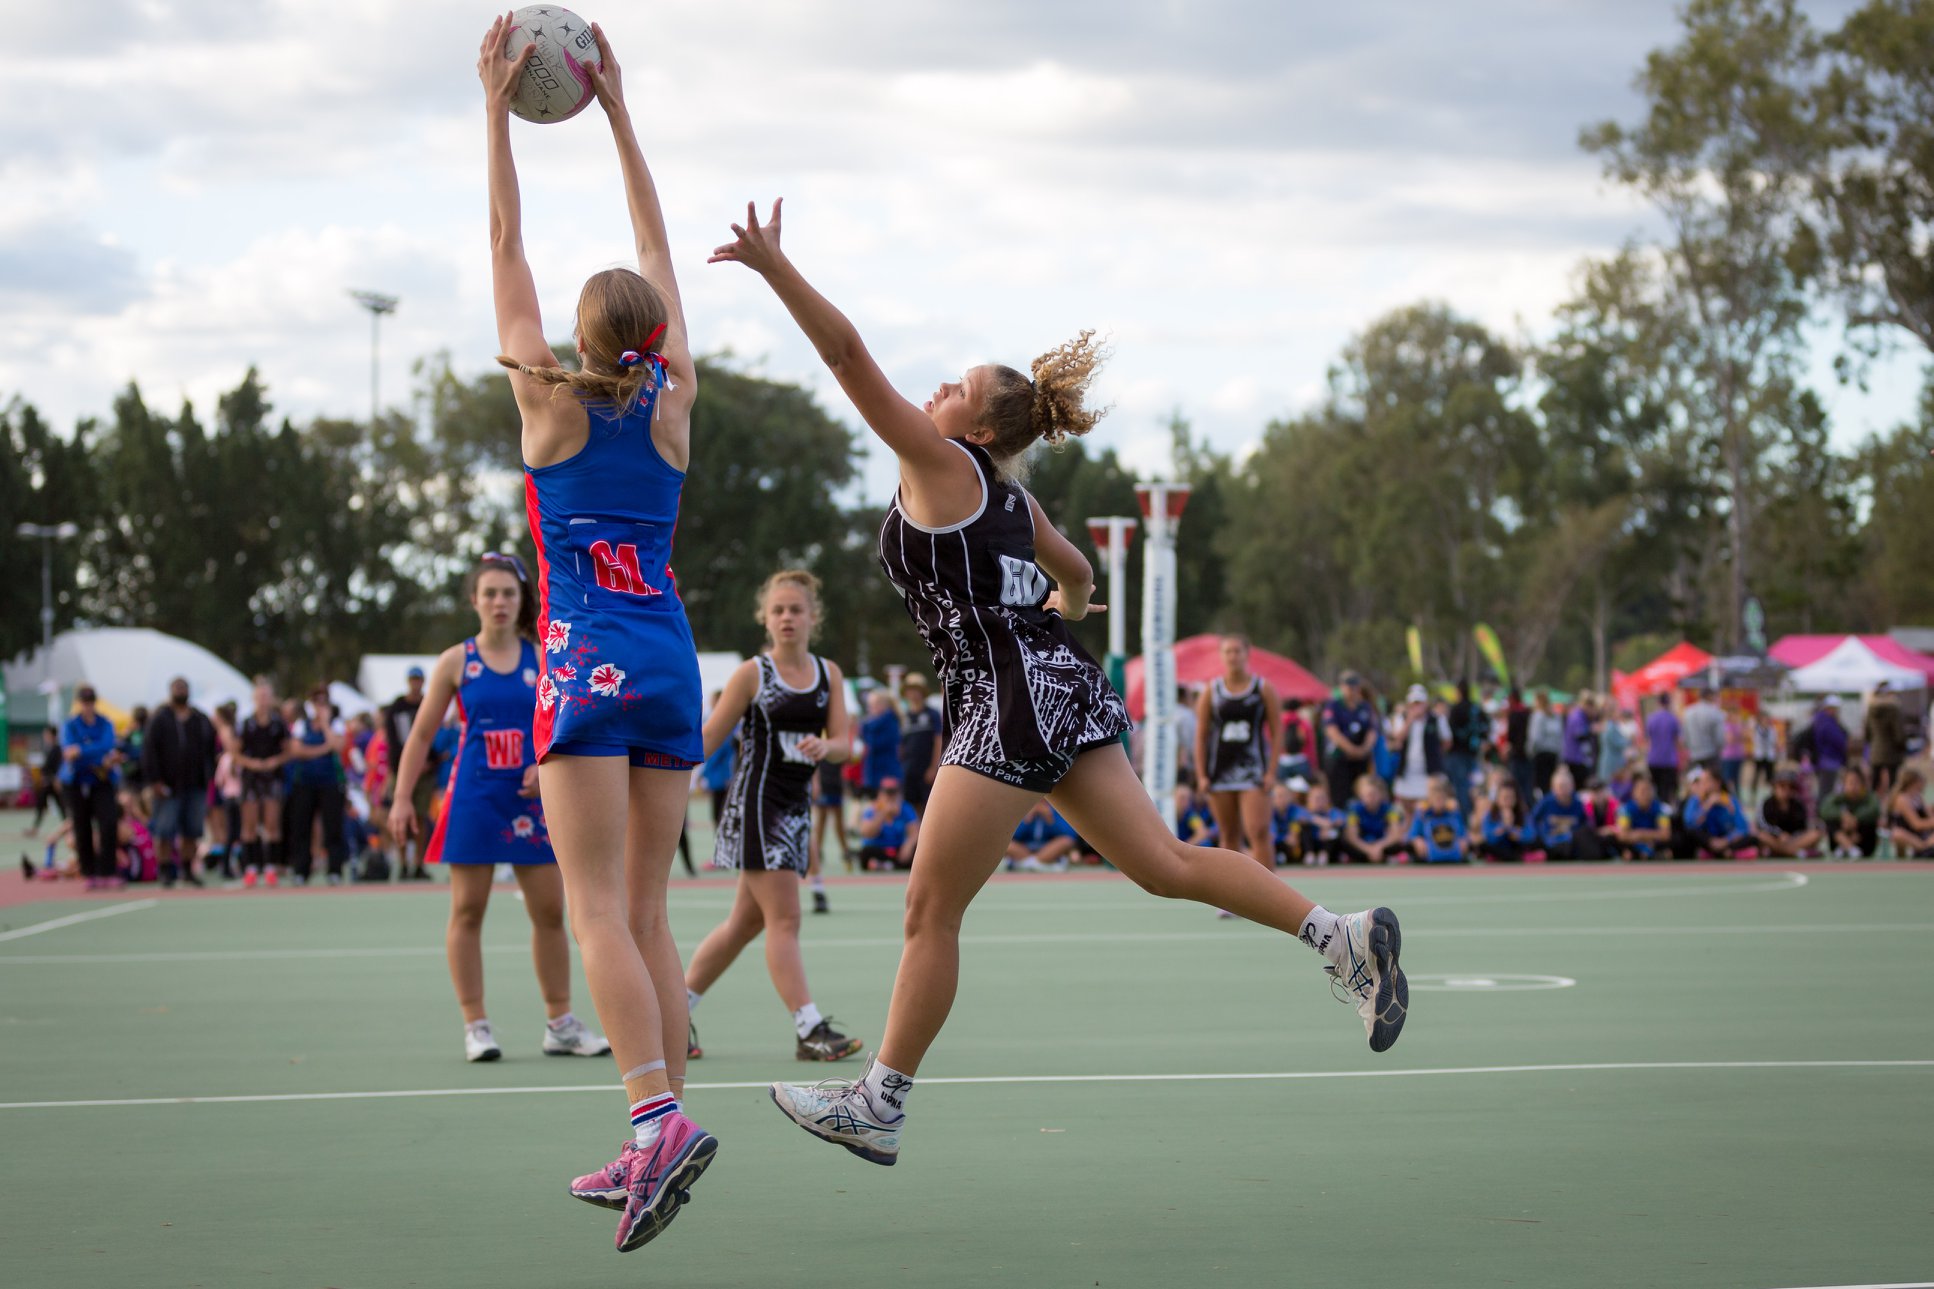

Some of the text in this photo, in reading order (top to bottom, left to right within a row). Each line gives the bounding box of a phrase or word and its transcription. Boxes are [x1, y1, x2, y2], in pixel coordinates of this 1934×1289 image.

[575, 25, 594, 49] GIL
[962, 669, 977, 714] Park
[995, 769, 1024, 784] Park
